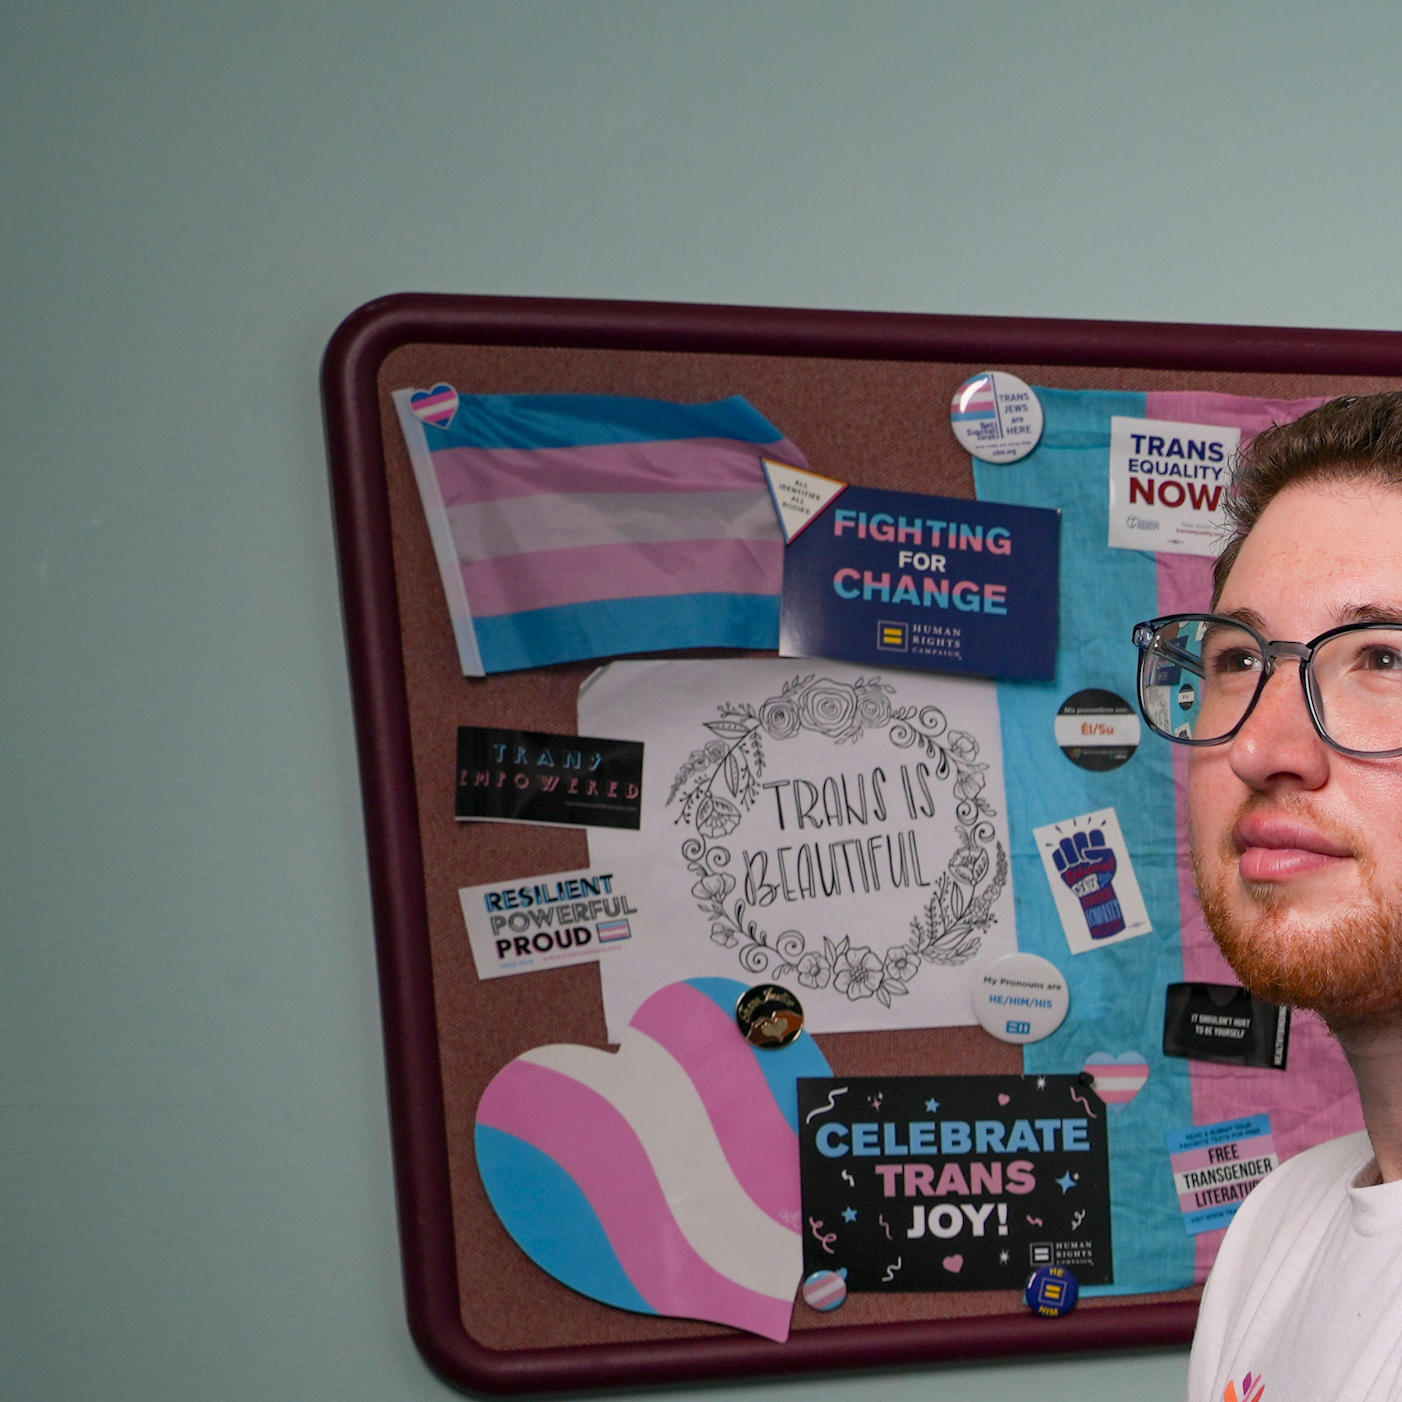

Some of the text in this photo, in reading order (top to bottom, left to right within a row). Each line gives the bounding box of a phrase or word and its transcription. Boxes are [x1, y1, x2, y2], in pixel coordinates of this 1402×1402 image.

[999, 393, 1029, 402] TRANS
[1004, 404, 1028, 414] JEWS
[1006, 425, 1031, 434] HERE
[1130, 434, 1224, 462] TRANS
[1128, 459, 1223, 481] EQUALITY
[1129, 477, 1223, 511] NOW
[834, 509, 1011, 555] FIGHTING
[899, 551, 946, 572] FOR
[833, 567, 1007, 615] CHANGE
[913, 624, 961, 637] HUMAN
[913, 636, 960, 649] RIGHTS
[1081, 722, 1114, 735] Él/Su
[494, 744, 603, 771] TRANS
[459, 769, 640, 800] EMPOWERED
[762, 761, 936, 831] TRANS IS
[742, 830, 931, 907] BEAUTIFUL
[484, 873, 614, 913] RESILIENT
[490, 896, 638, 936] POWERFUL
[496, 926, 592, 960] PROUD
[983, 975, 1062, 991] My Pronouns are
[989, 994, 1053, 1008] HE/HIM/HIS
[1191, 1013, 1198, 1023] IT
[1233, 1018, 1251, 1028] HURT
[1195, 1025, 1245, 1039] TO BE YOURSELF
[815, 1117, 1090, 1158] CELEBRATE
[1208, 1144, 1239, 1164] FREE
[875, 1160, 1037, 1197] TRANS
[1184, 1158, 1273, 1189] TRANSGENDER
[907, 1203, 1008, 1239] JOY!
